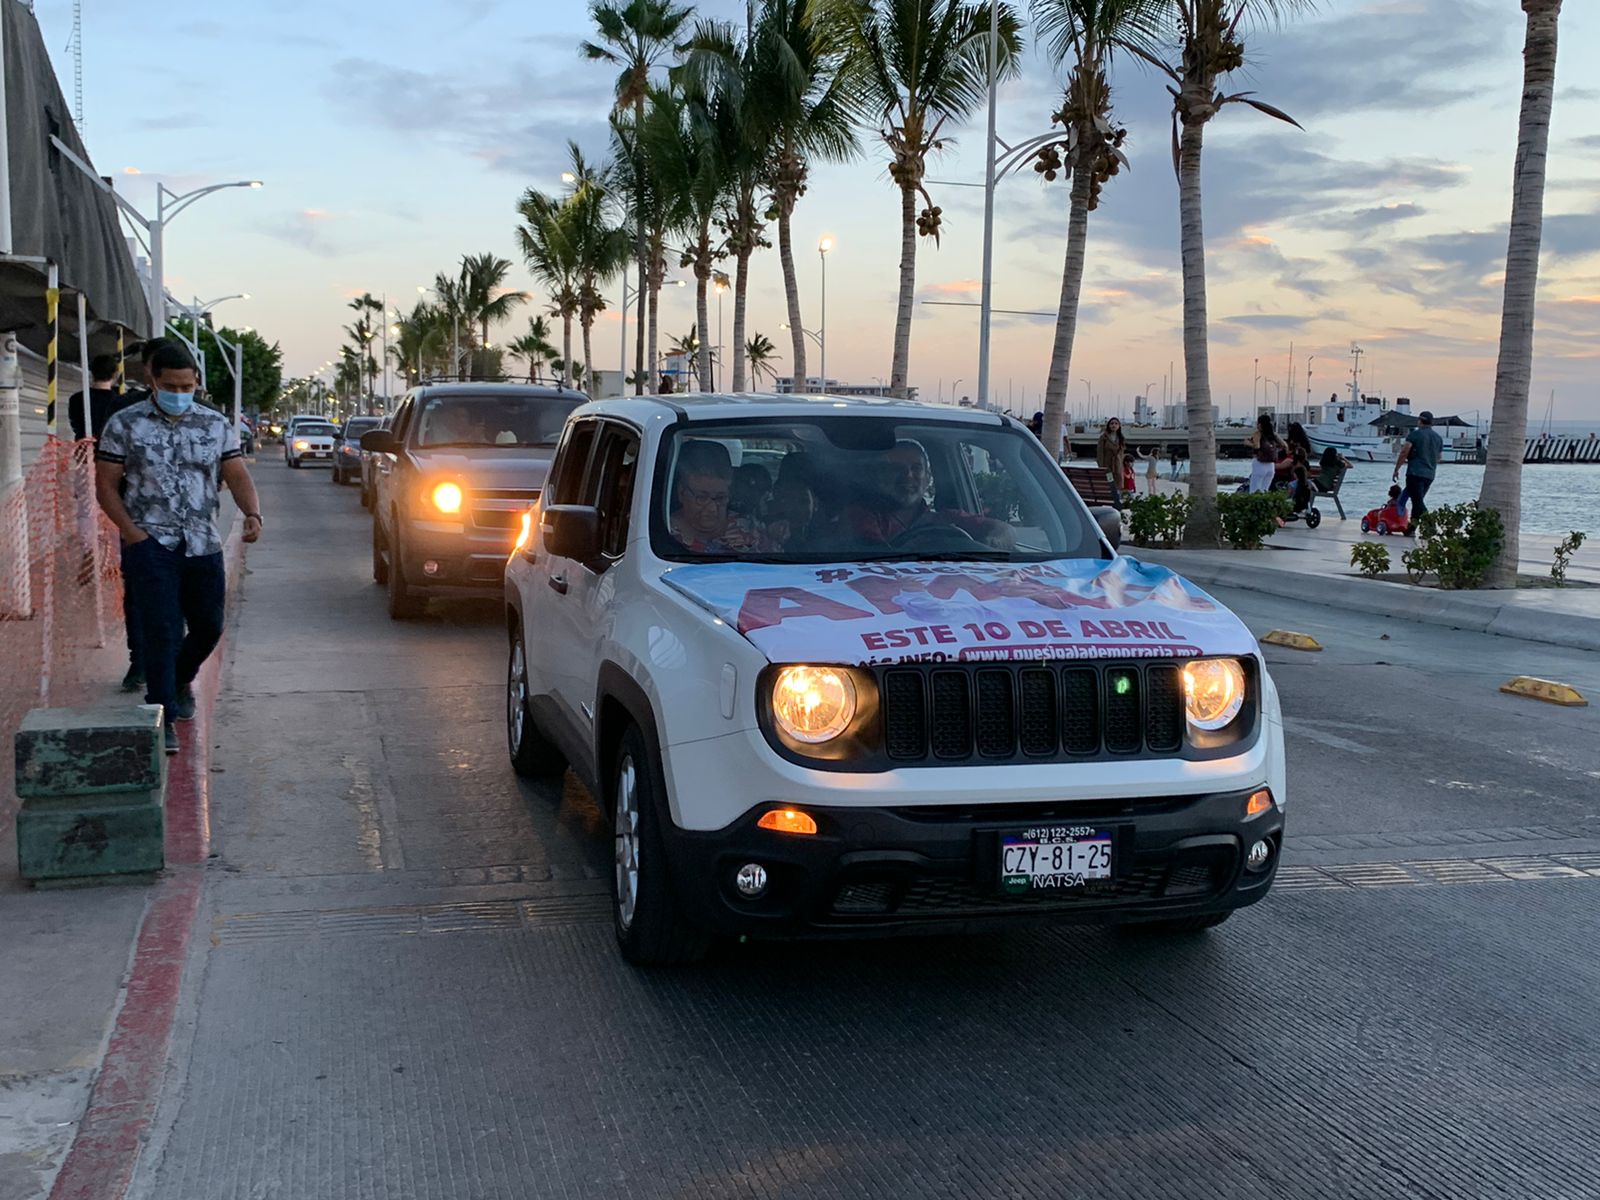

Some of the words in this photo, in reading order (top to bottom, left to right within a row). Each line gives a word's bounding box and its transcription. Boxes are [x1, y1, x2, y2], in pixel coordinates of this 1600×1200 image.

[860, 624, 958, 651] ESTE
[962, 621, 1011, 642] 10
[1017, 619, 1073, 639] DE
[1080, 619, 1187, 641] ABRIL
[1027, 828, 1049, 839] (612)
[1003, 844, 1111, 874] CZY-81-25
[1008, 877, 1027, 885] Jeep
[1033, 873, 1086, 889] NATSA
